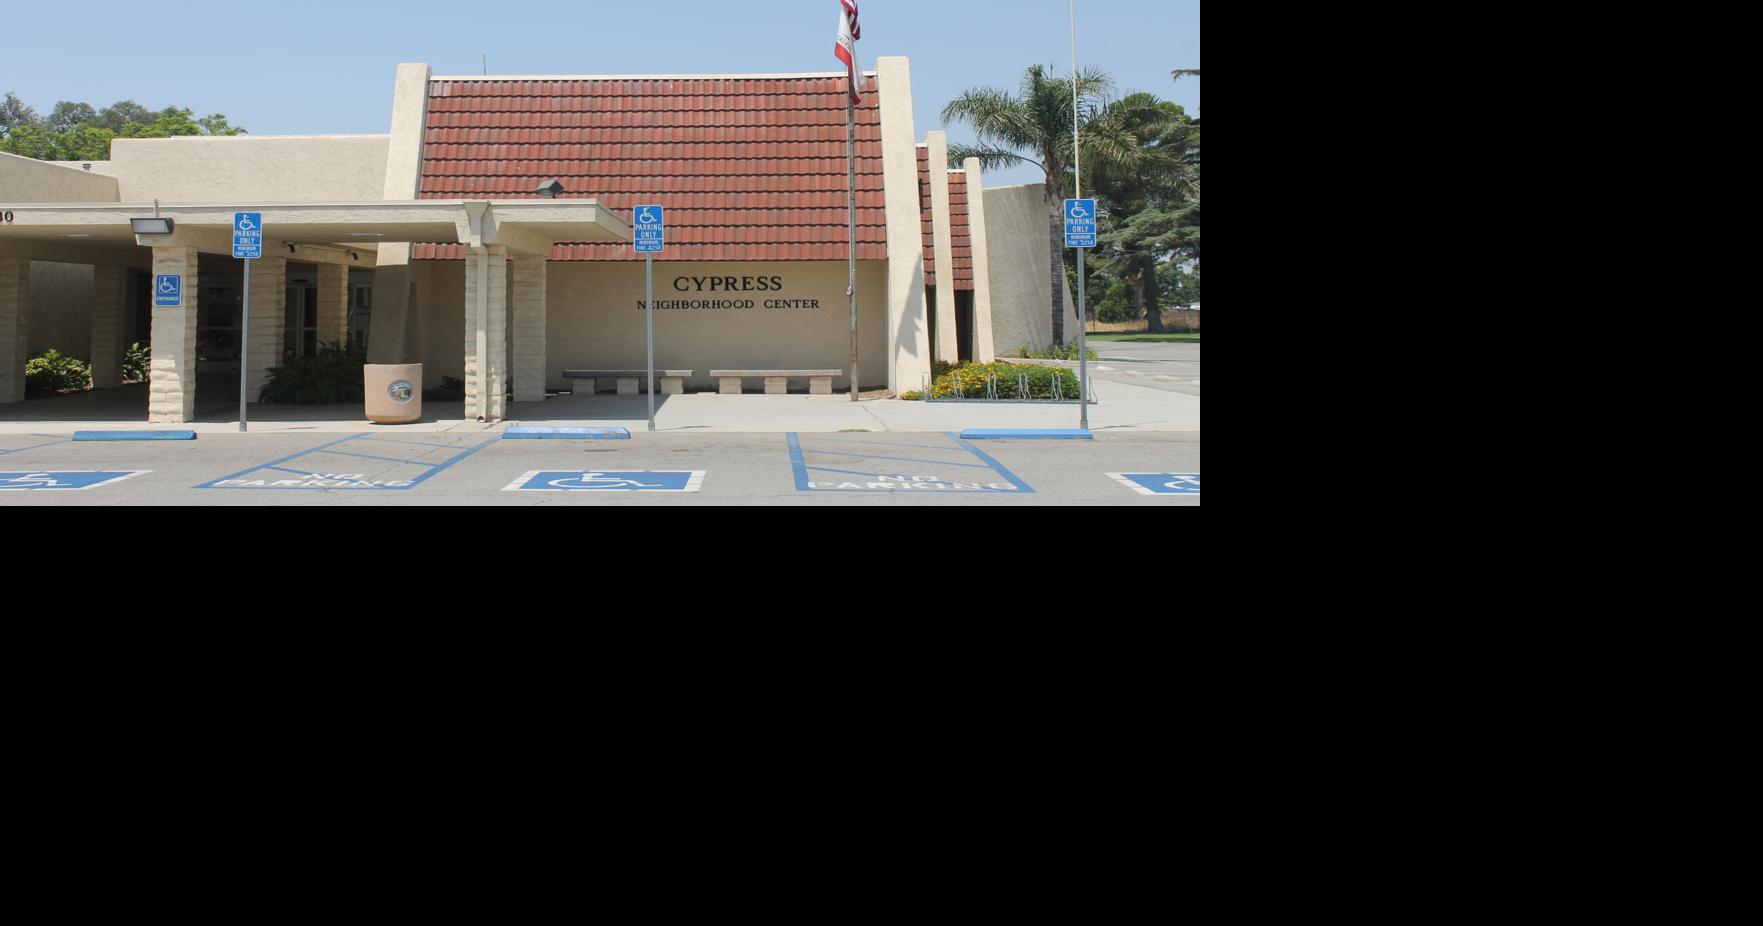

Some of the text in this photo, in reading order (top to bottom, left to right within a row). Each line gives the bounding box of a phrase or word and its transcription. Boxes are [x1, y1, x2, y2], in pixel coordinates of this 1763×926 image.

[1066, 217, 1094, 225] PARKING
[635, 223, 662, 231] PARKING
[1072, 225, 1089, 233] ONLY
[673, 275, 783, 292] CYPRESS
[763, 299, 821, 309] CENTER
[878, 474, 939, 482] NO
[211, 479, 416, 487] PARKING
[807, 481, 1020, 490] PARKING
